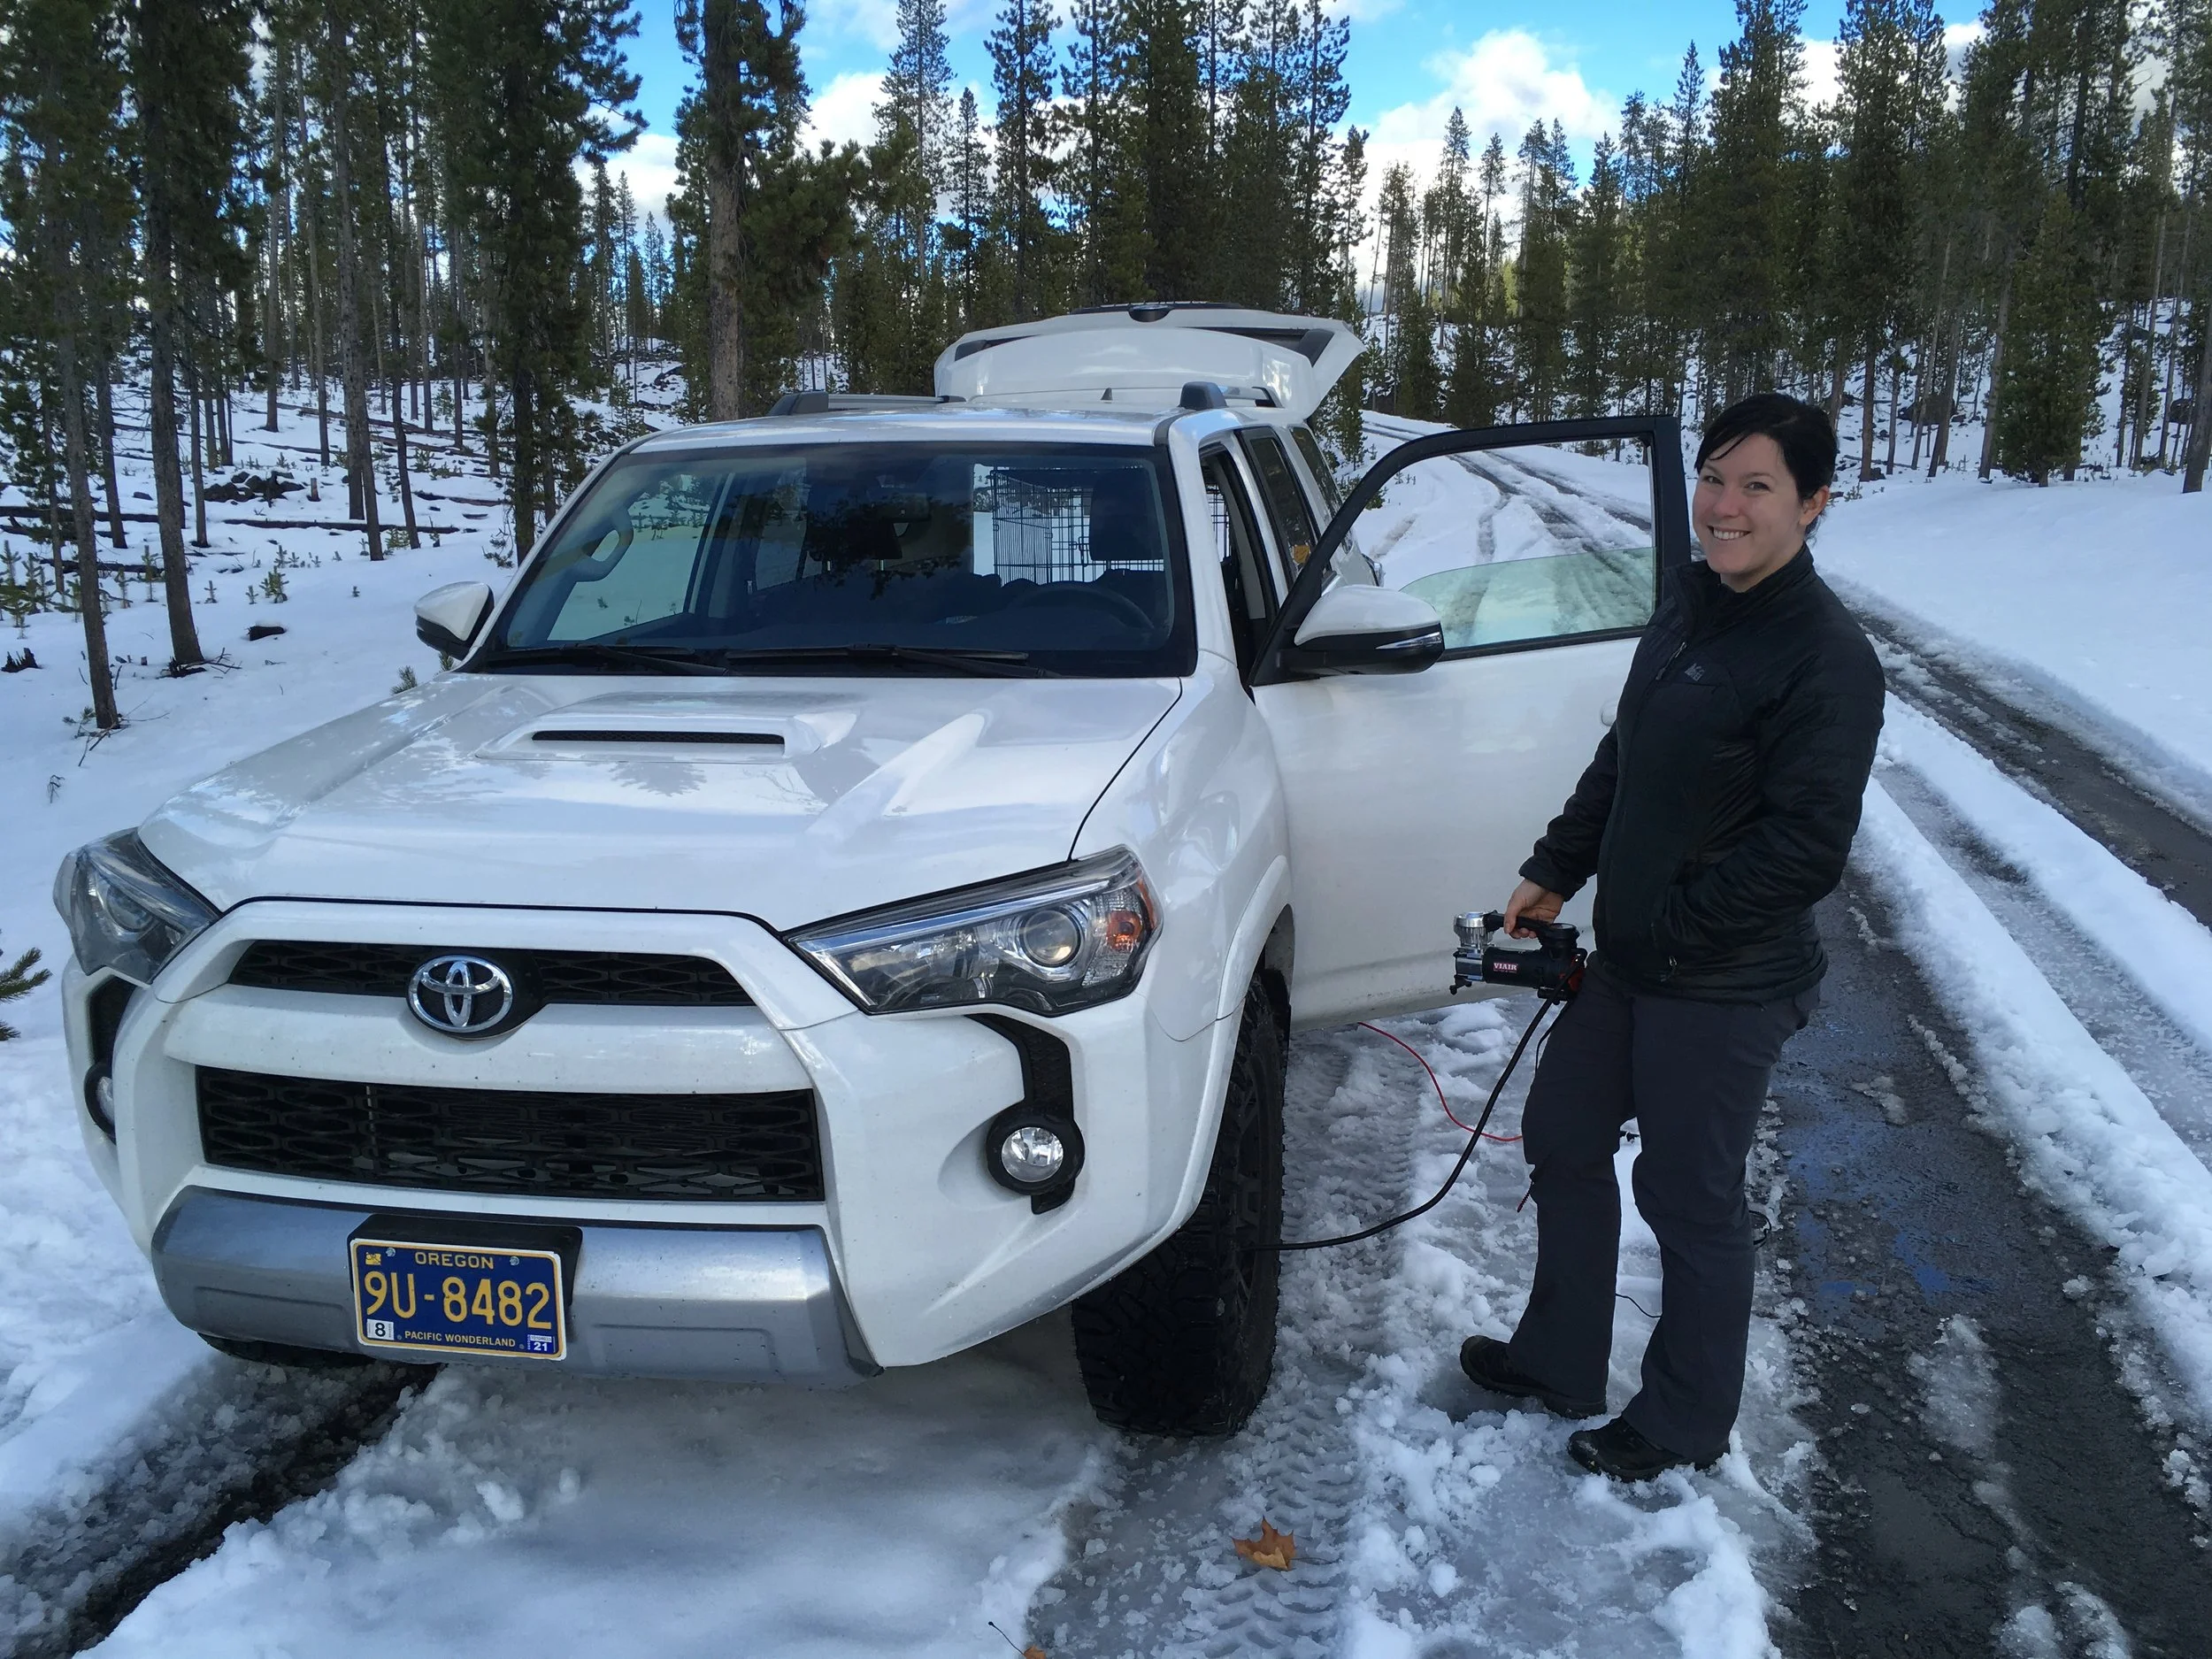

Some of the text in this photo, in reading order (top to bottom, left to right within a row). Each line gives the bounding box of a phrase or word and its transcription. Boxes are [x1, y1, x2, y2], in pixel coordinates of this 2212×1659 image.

[1494, 962, 1517, 971] VIAIR
[414, 1251, 494, 1270] OREGON
[364, 1271, 552, 1330] 9U-8482
[374, 1322, 386, 1337] 8
[404, 1330, 442, 1342] PACIFIC
[444, 1333, 516, 1348] WONDERLAND
[534, 1341, 548, 1352] 21
